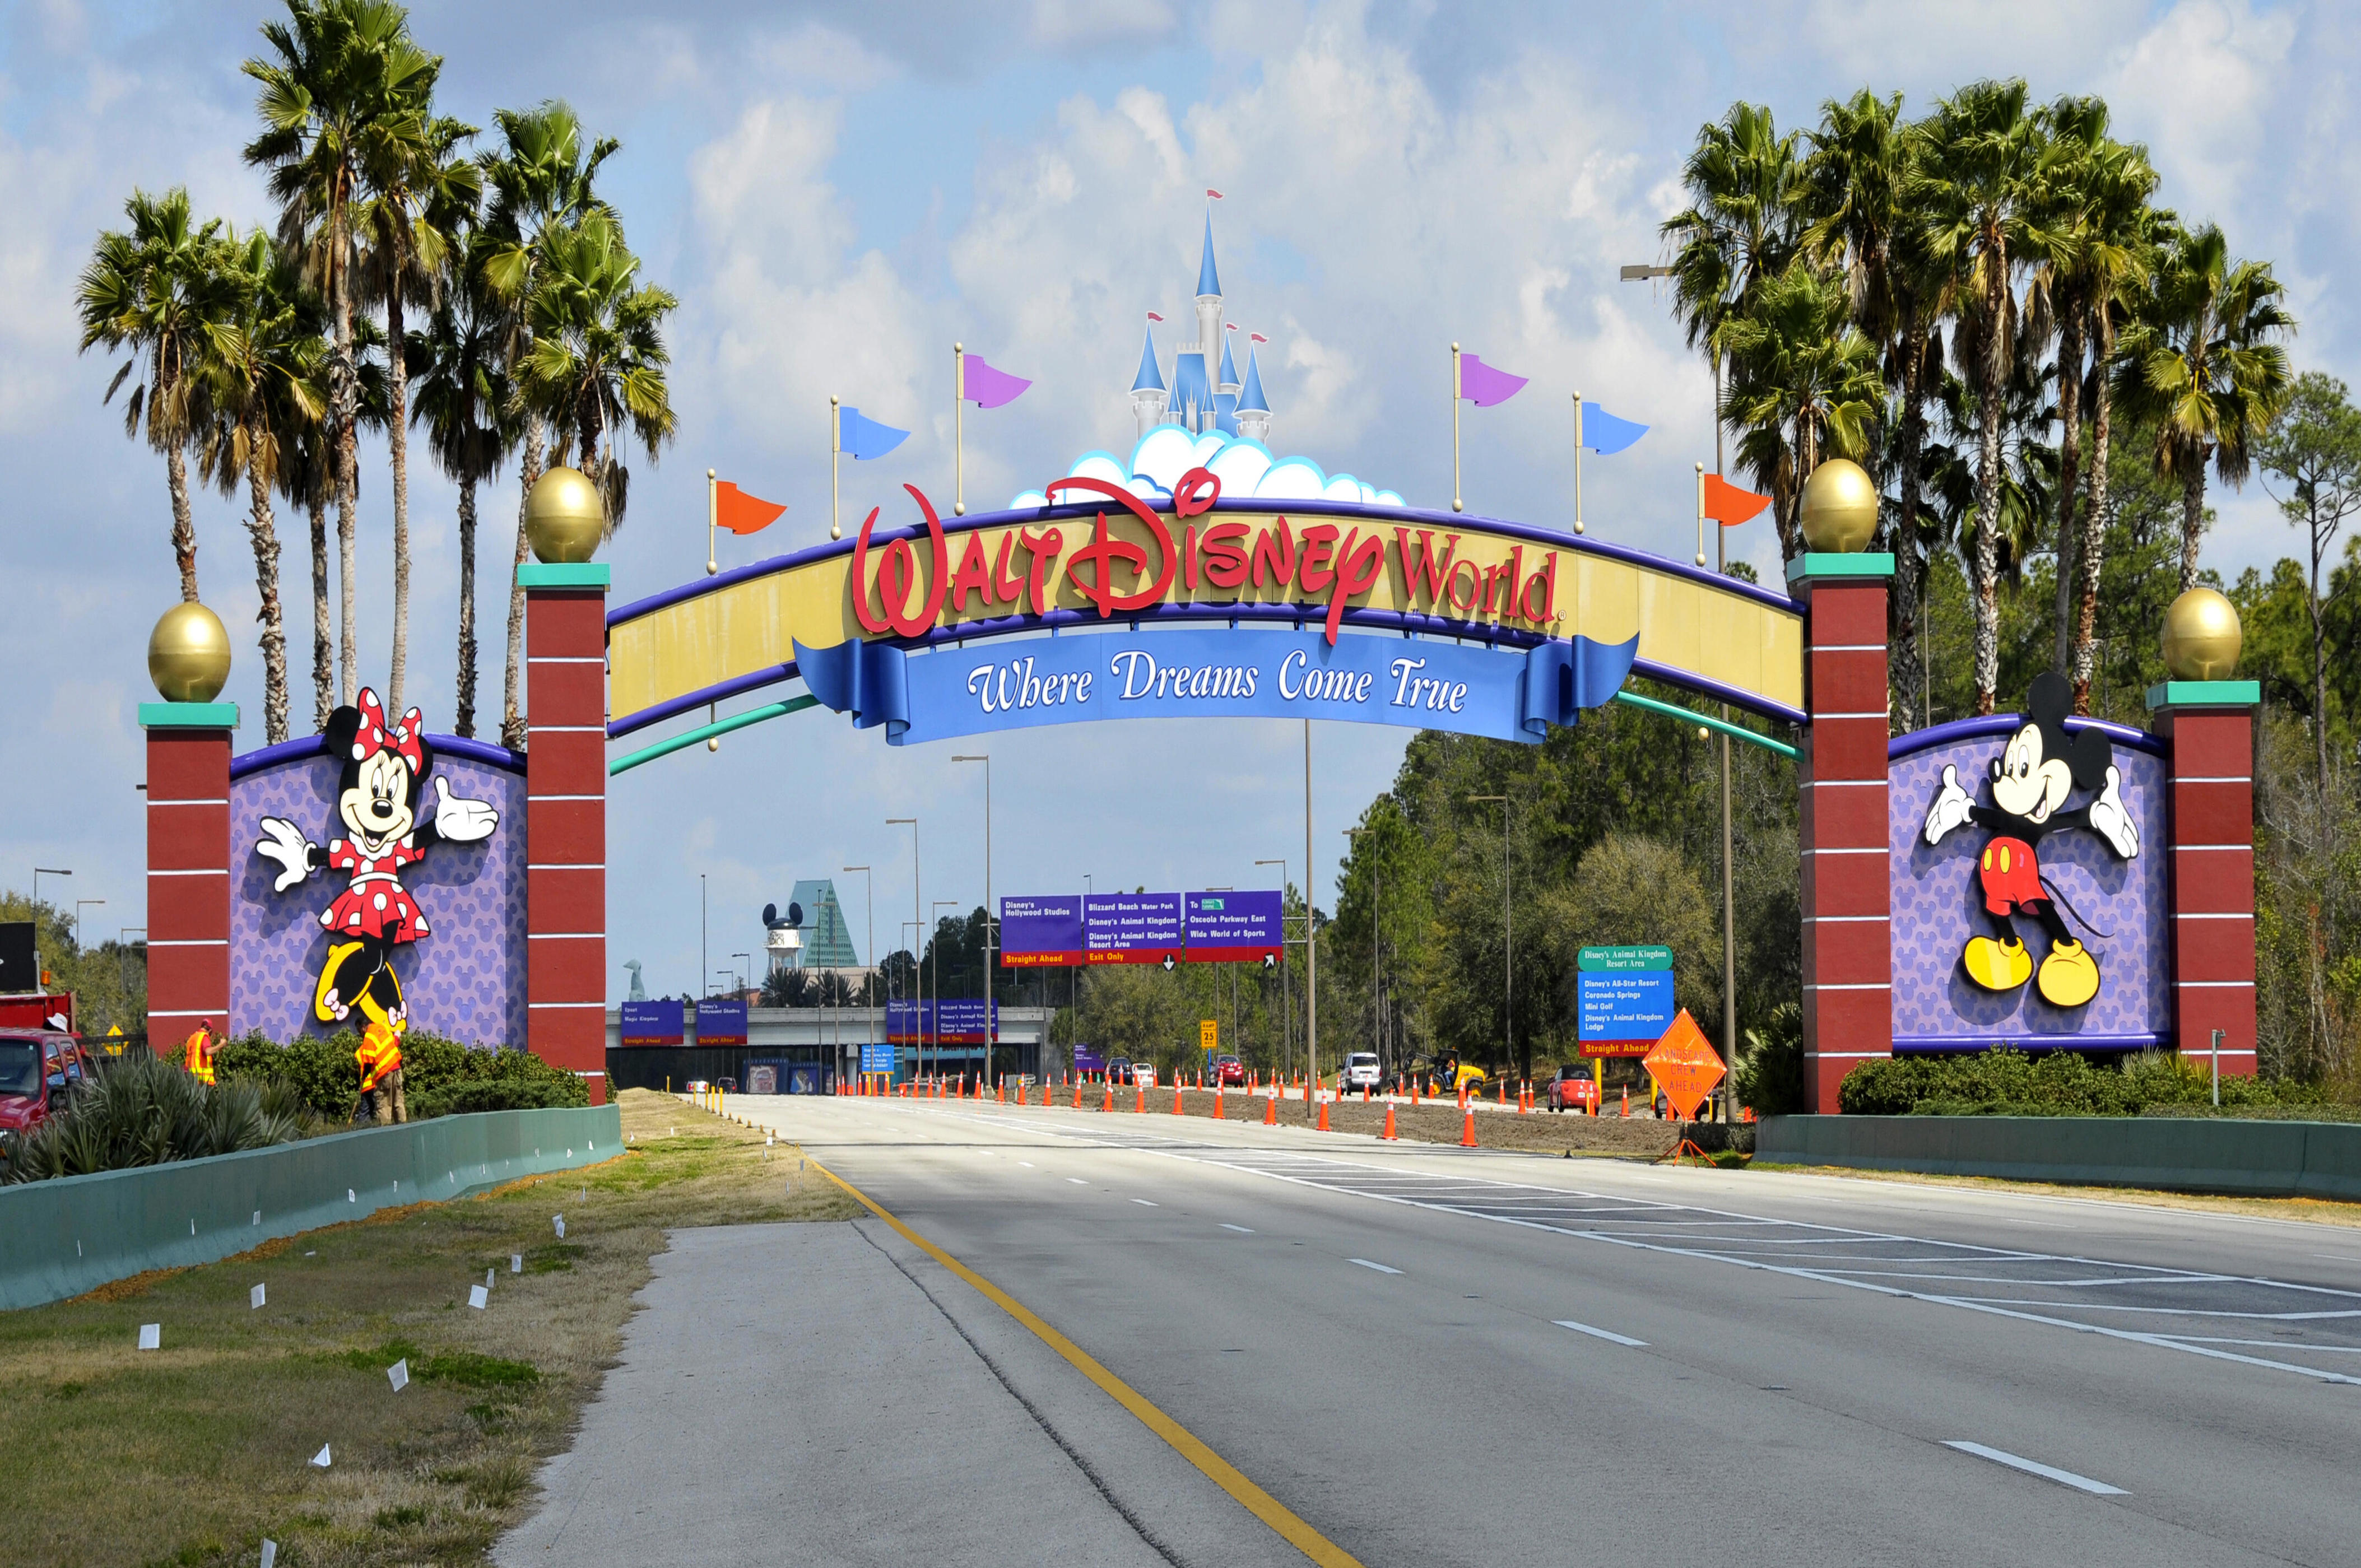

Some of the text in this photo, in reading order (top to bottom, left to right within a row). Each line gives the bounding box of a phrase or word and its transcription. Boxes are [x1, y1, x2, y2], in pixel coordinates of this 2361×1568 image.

[968, 649, 1467, 713] Where Dreams Come True
[1006, 909, 1042, 917] Hollywood
[1089, 918, 1117, 926] Disney's
[1147, 917, 1177, 925] Kingdom
[1220, 915, 1248, 924] Parkway
[1089, 932, 1117, 941] Disney's
[1147, 931, 1177, 940] Kingdom
[1243, 930, 1265, 938] Sports
[1006, 955, 1036, 964] Straight
[1107, 952, 1123, 962] Only
[1585, 951, 1609, 960] Disney's
[1639, 950, 1666, 959] Kingdom
[1586, 1045, 1619, 1054] Straight
[1659, 1049, 1711, 1062] LANDSCAPE
[1671, 1065, 1697, 1076] CREW
[1669, 1081, 1702, 1093] AHEAD
